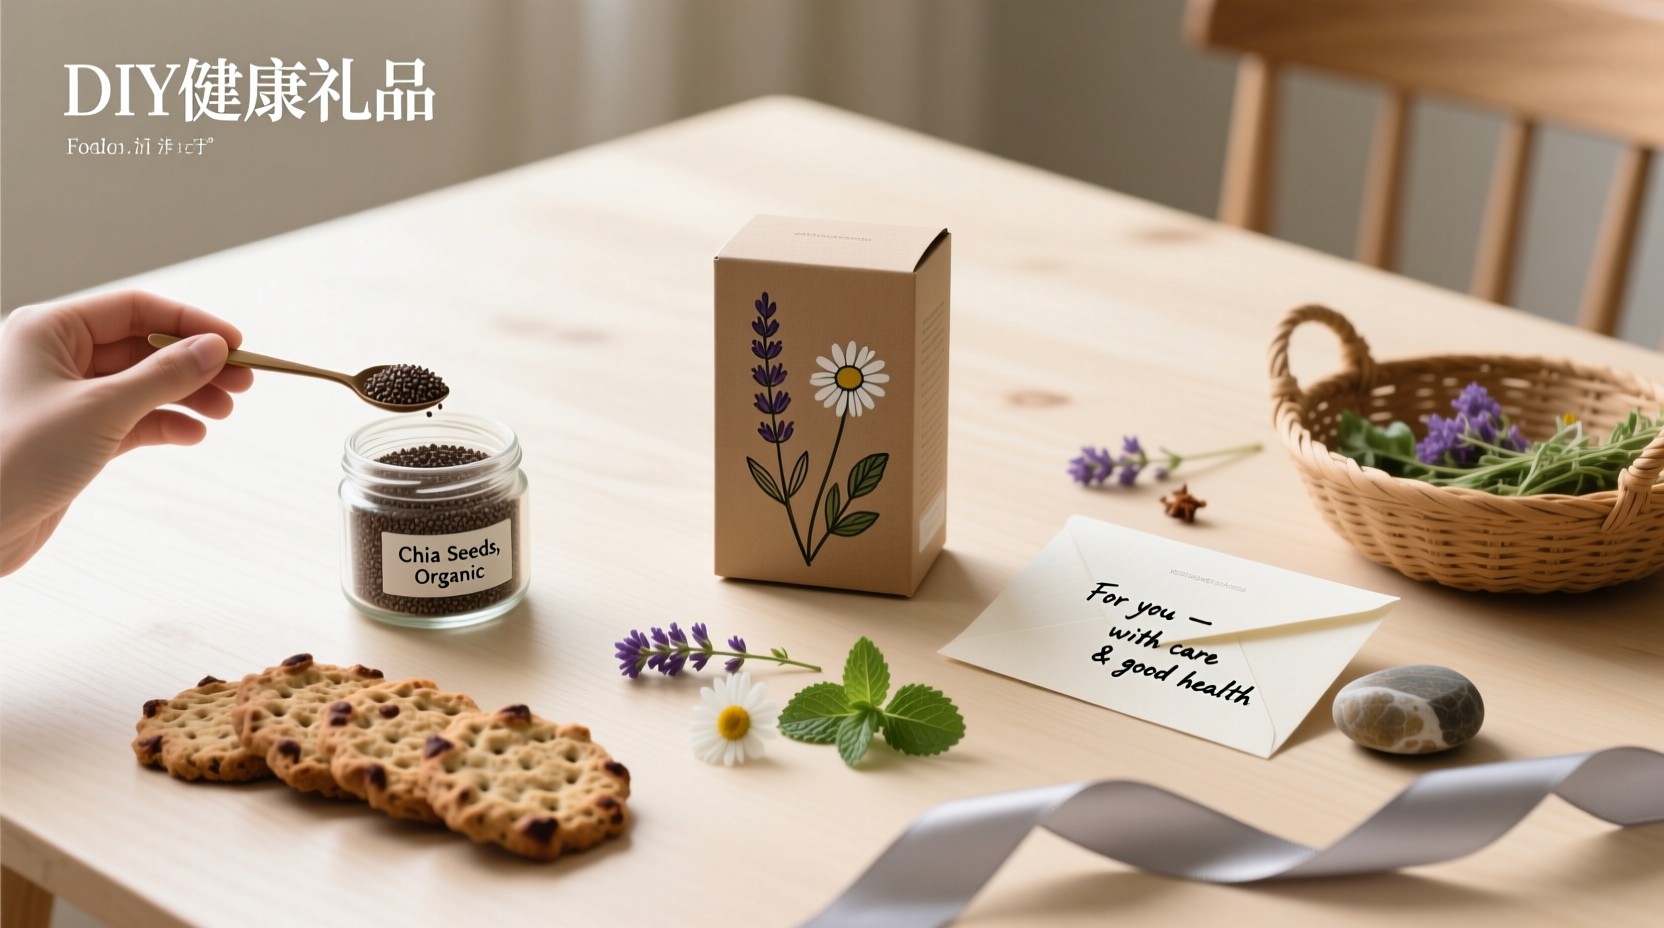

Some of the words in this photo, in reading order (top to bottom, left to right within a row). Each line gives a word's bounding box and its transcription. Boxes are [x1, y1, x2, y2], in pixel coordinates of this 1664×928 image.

[398, 545, 440, 563] Chia
[447, 538, 500, 562] Seeds,
[415, 564, 485, 589] Organic
[1086, 582, 1129, 606] For
[1125, 601, 1175, 621] you
[1109, 626, 1163, 649] with
[1169, 644, 1218, 665] care
[1091, 645, 1114, 665] &
[1111, 659, 1179, 681] good
[1176, 671, 1255, 706] health
